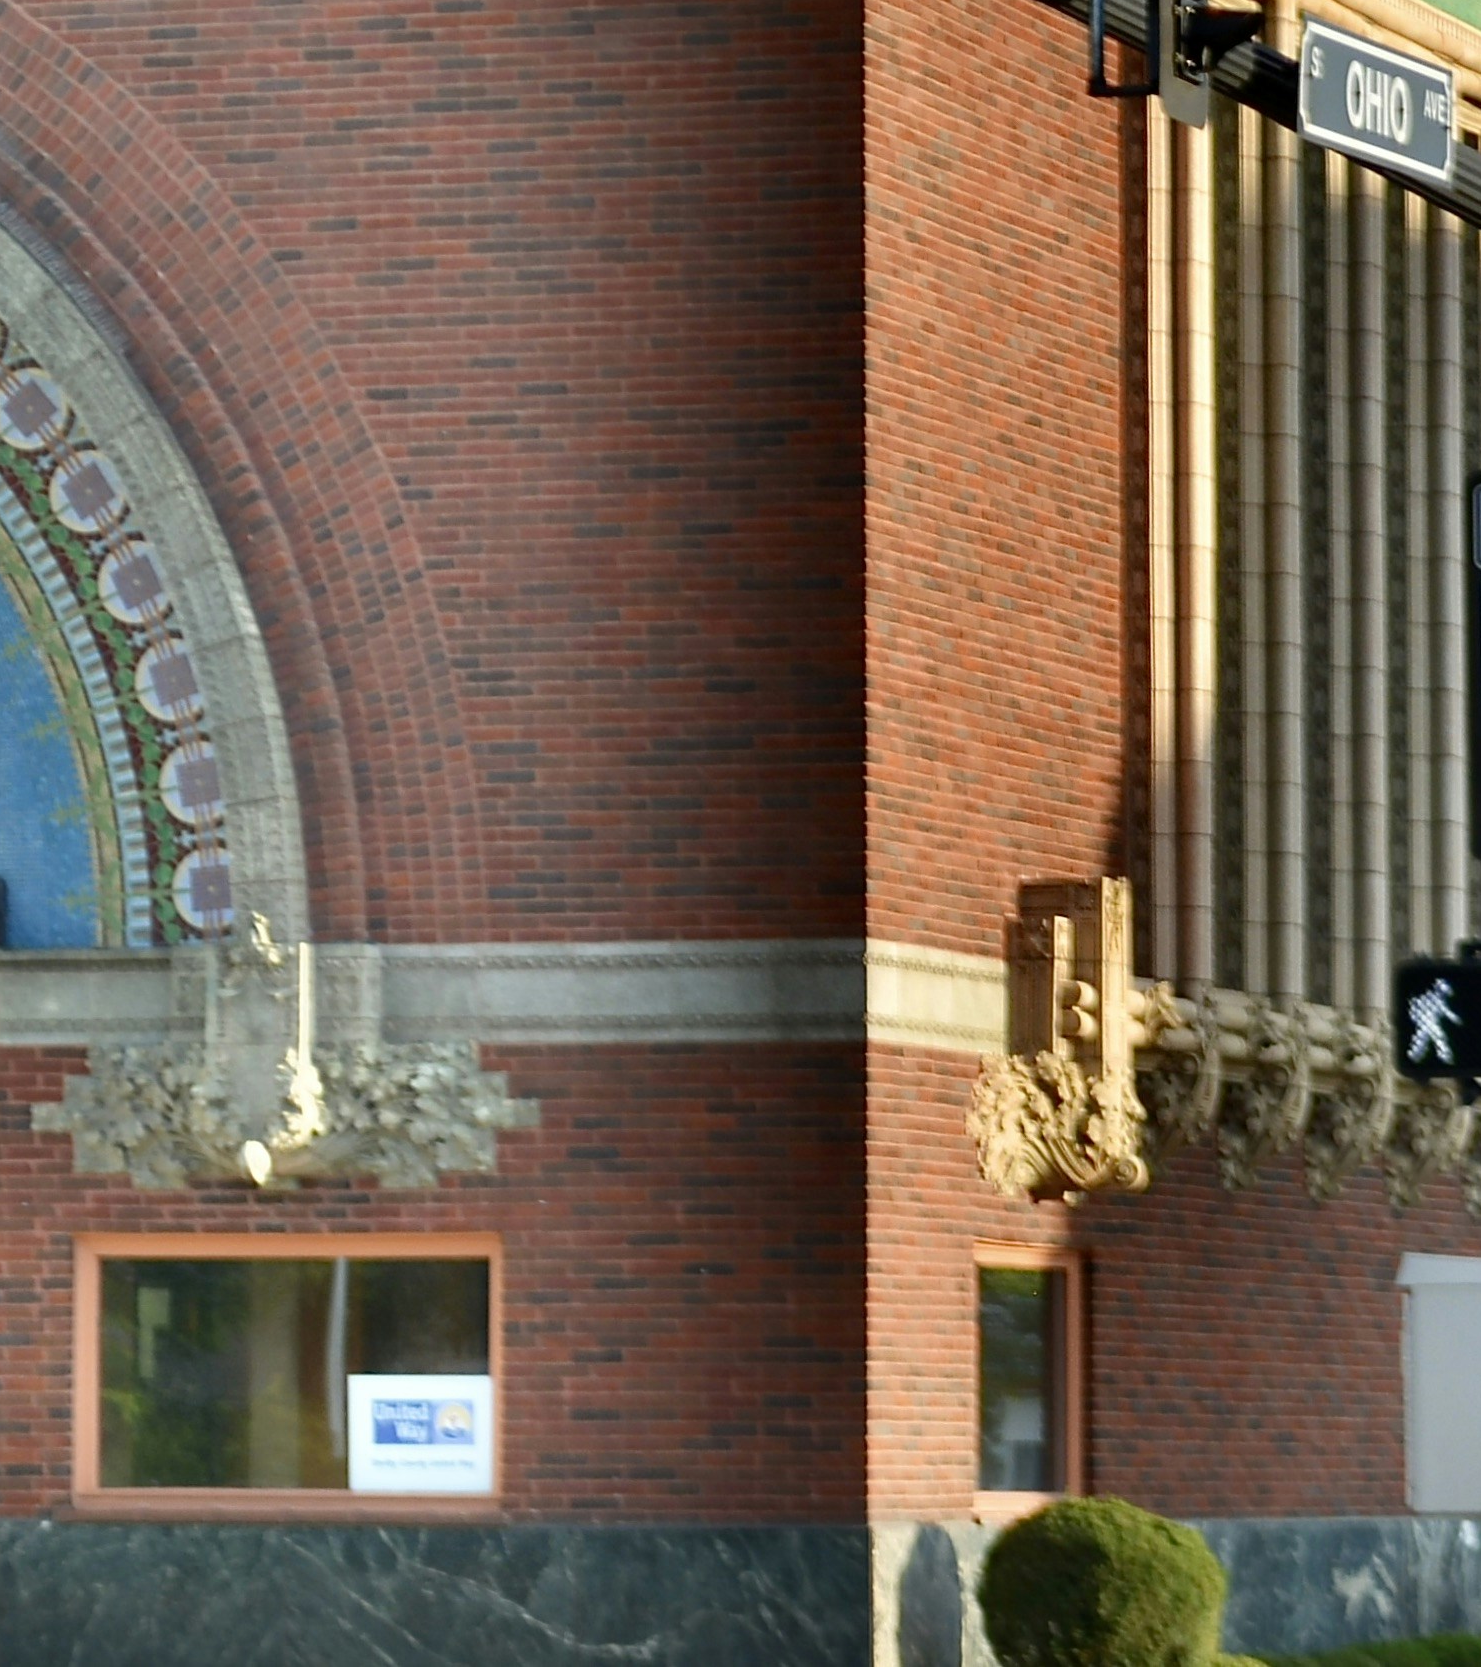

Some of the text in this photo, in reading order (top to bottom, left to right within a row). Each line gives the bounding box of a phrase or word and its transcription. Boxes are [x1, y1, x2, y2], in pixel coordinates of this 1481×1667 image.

[1346, 59, 1414, 147] OHIO
[1423, 88, 1448, 125] AVE
[374, 1402, 429, 1421] United
[393, 1420, 428, 1443] Way
